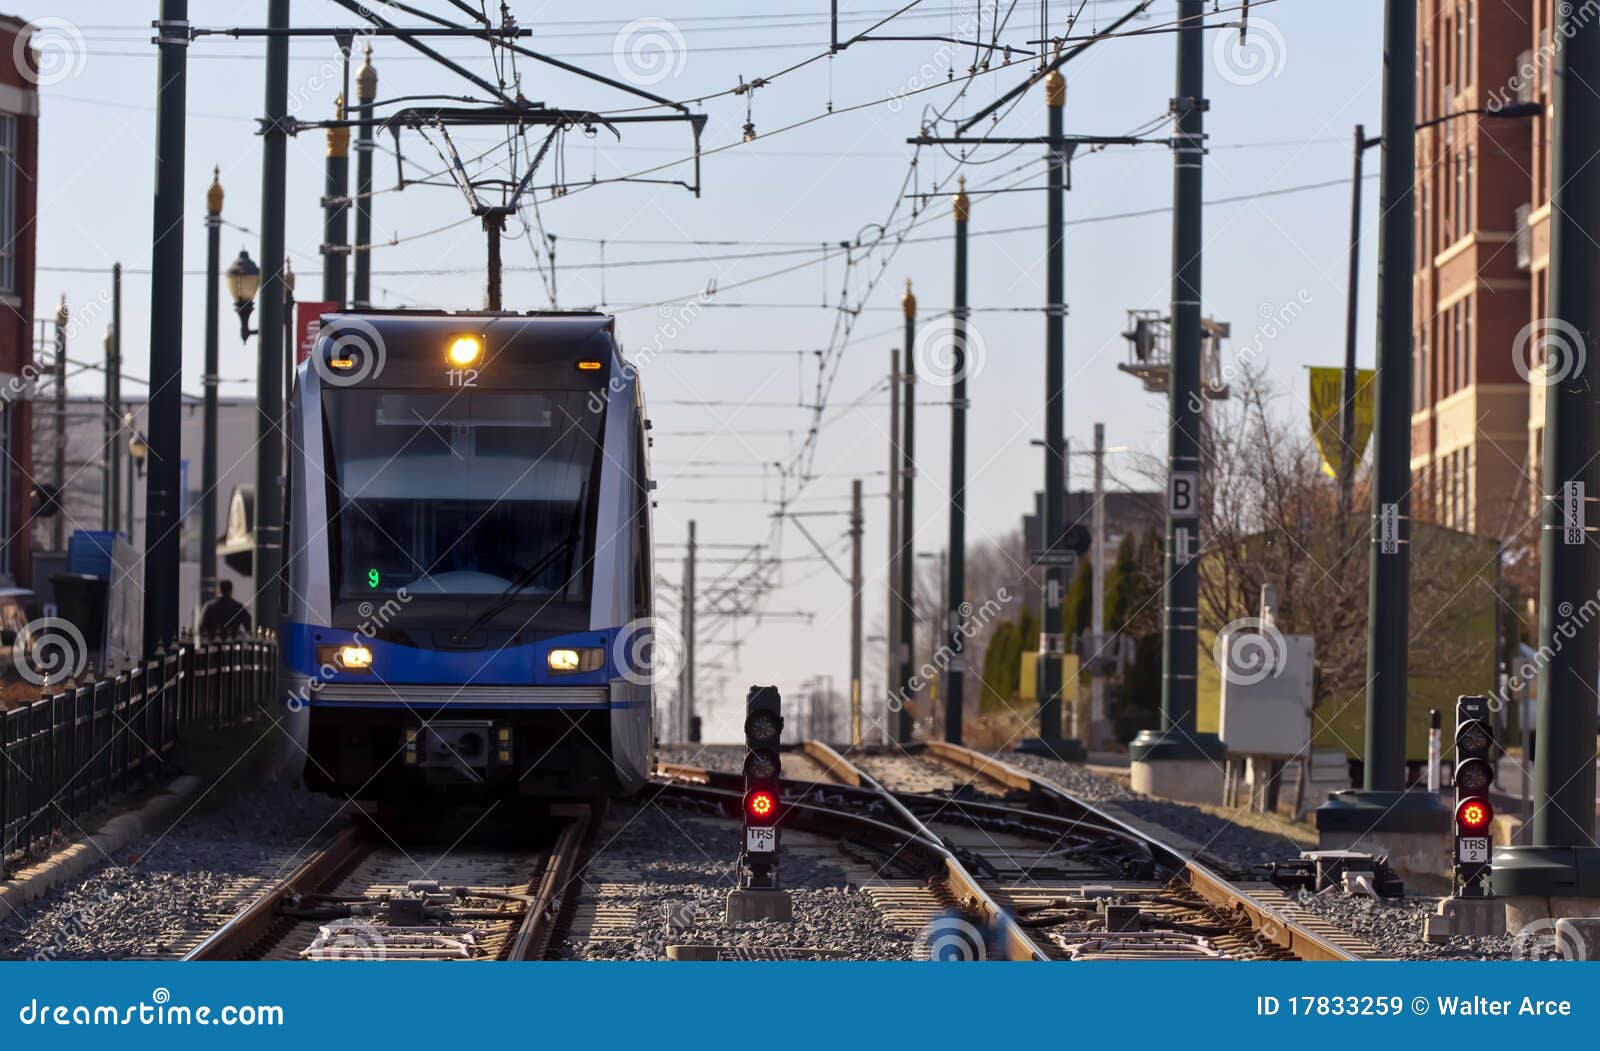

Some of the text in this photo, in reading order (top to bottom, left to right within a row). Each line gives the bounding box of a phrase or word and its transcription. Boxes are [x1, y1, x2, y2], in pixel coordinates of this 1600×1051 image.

[445, 369, 478, 387] 112
[1173, 478, 1191, 510] B
[368, 568, 379, 588] 9
[749, 828, 774, 840] TRS
[757, 840, 764, 850] 4
[1462, 839, 1487, 850] TRS
[1470, 850, 1478, 861] 2
